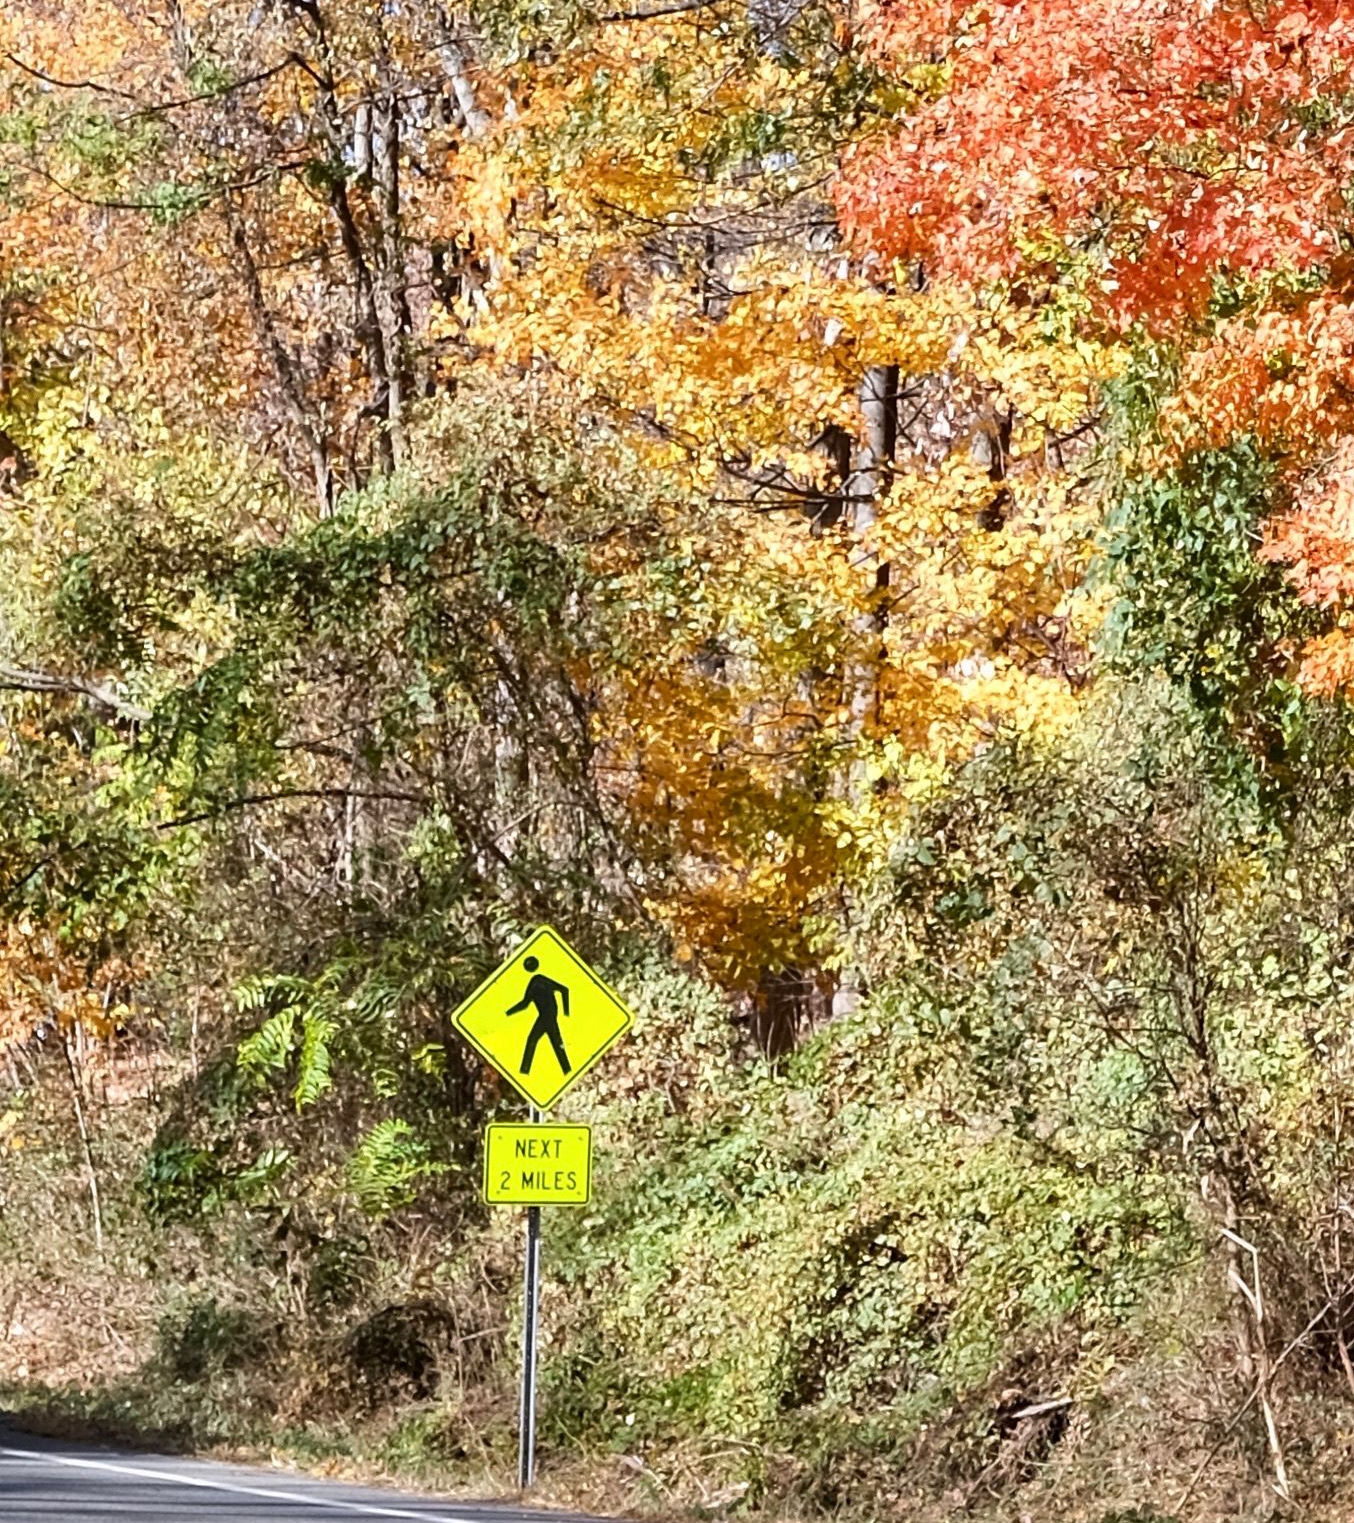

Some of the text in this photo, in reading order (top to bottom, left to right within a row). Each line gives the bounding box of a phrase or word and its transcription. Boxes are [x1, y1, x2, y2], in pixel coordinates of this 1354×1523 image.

[516, 1139, 562, 1158] NEXT
[500, 1171, 577, 1190] 2 MILES
